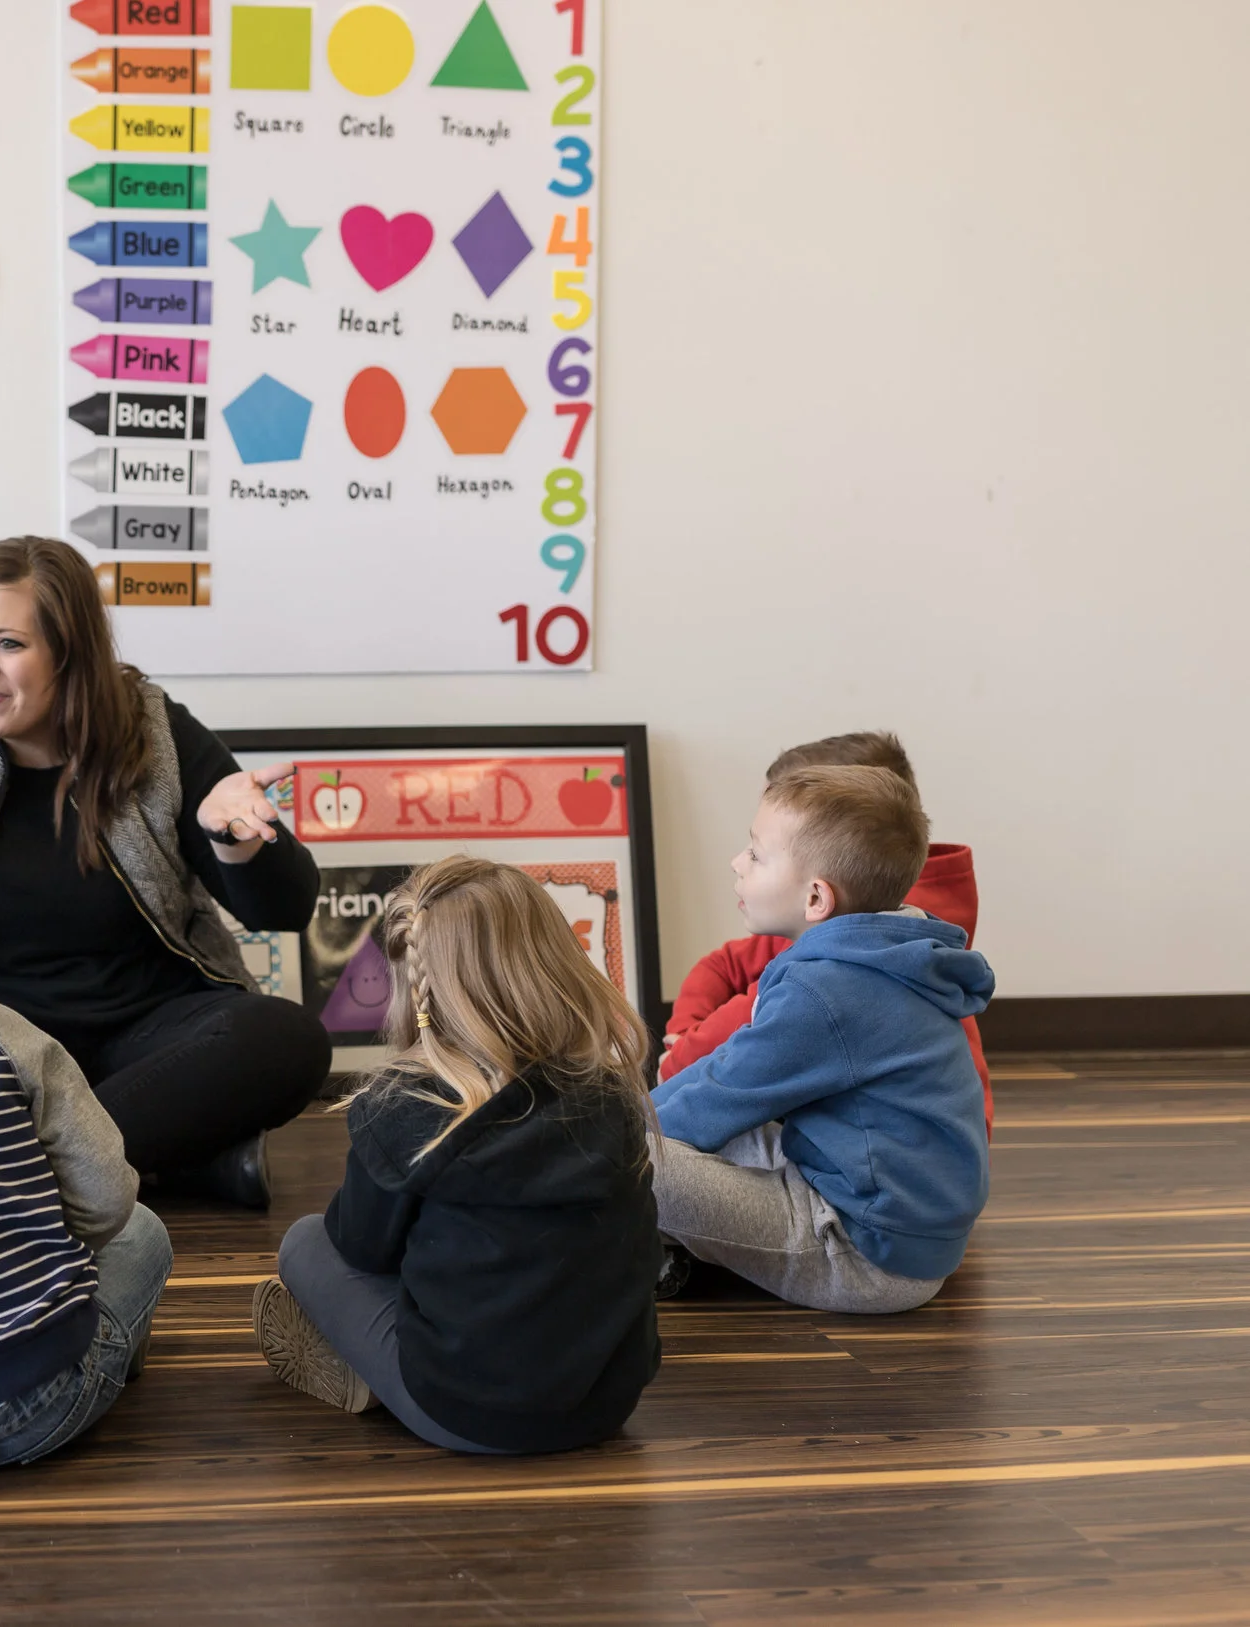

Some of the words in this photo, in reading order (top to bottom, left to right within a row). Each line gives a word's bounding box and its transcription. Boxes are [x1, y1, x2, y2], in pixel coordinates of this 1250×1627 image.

[127, 0, 180, 24] Red
[554, 0, 585, 56] 1
[119, 62, 189, 83] Orange
[551, 64, 595, 126] 2
[123, 119, 184, 138] Yellow
[234, 110, 304, 138] Square
[339, 115, 395, 138] Circle
[440, 116, 511, 145] Triangle
[547, 136, 594, 198] 3
[119, 177, 185, 197] Green
[123, 231, 180, 256] Blue
[546, 206, 593, 267] 4
[124, 292, 187, 314] Purple
[551, 270, 592, 331] 5
[250, 314, 297, 334] Star
[339, 308, 403, 336] Heart
[452, 312, 528, 334] Diamond
[124, 345, 180, 371] Pink
[546, 337, 592, 397] 6
[117, 402, 185, 428] Black
[555, 402, 593, 460] 7
[122, 462, 185, 482] White
[230, 479, 311, 507] Pentagon
[347, 481, 392, 500] Oval
[437, 475, 514, 498] Hexagon
[541, 467, 587, 527] 8
[124, 518, 181, 542] Gray
[540, 533, 586, 594] 9
[123, 577, 188, 595] Brown
[498, 603, 590, 666] 10
[392, 768, 533, 828] RED
[313, 887, 398, 918] rian
